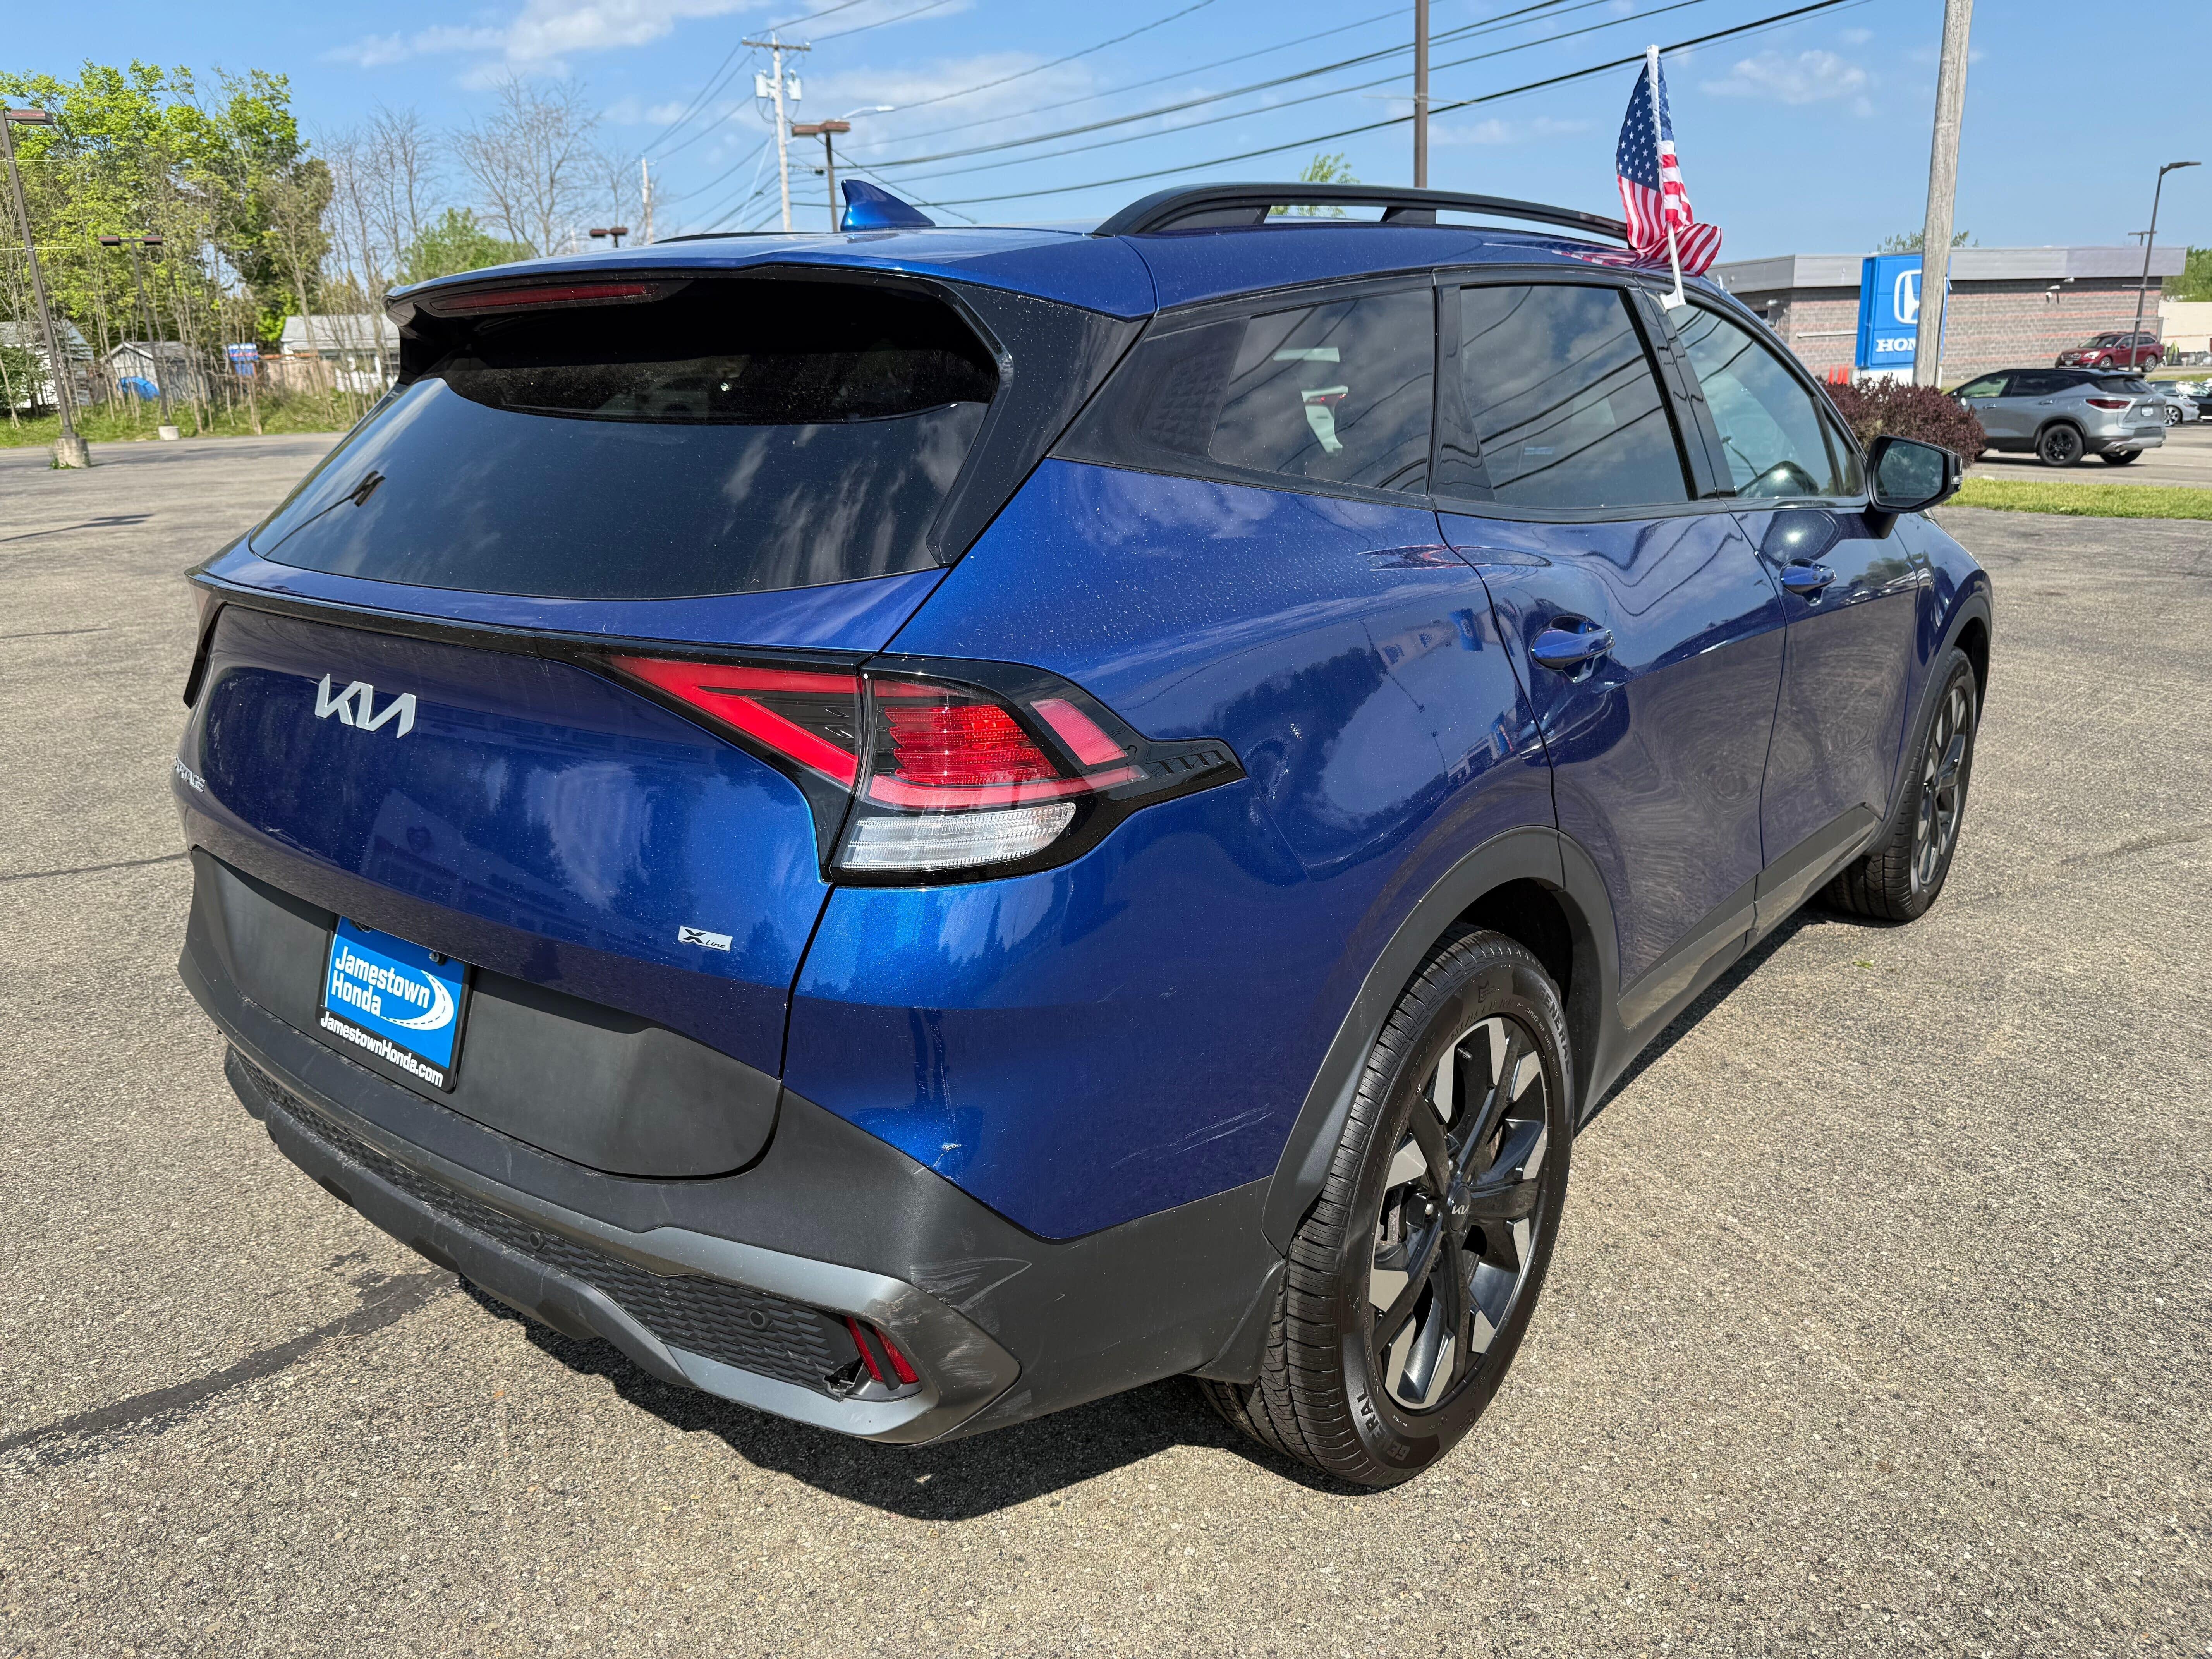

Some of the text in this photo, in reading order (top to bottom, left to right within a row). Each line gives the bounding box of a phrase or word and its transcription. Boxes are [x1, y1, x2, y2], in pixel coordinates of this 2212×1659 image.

[1875, 338, 1916, 352] HON
[314, 673, 417, 738] KIA
[331, 970, 381, 1017] Honda
[336, 946, 429, 1008] Jamestown
[321, 1011, 443, 1087] JamestownHonda.com
[1451, 1205, 1469, 1214] KIA
